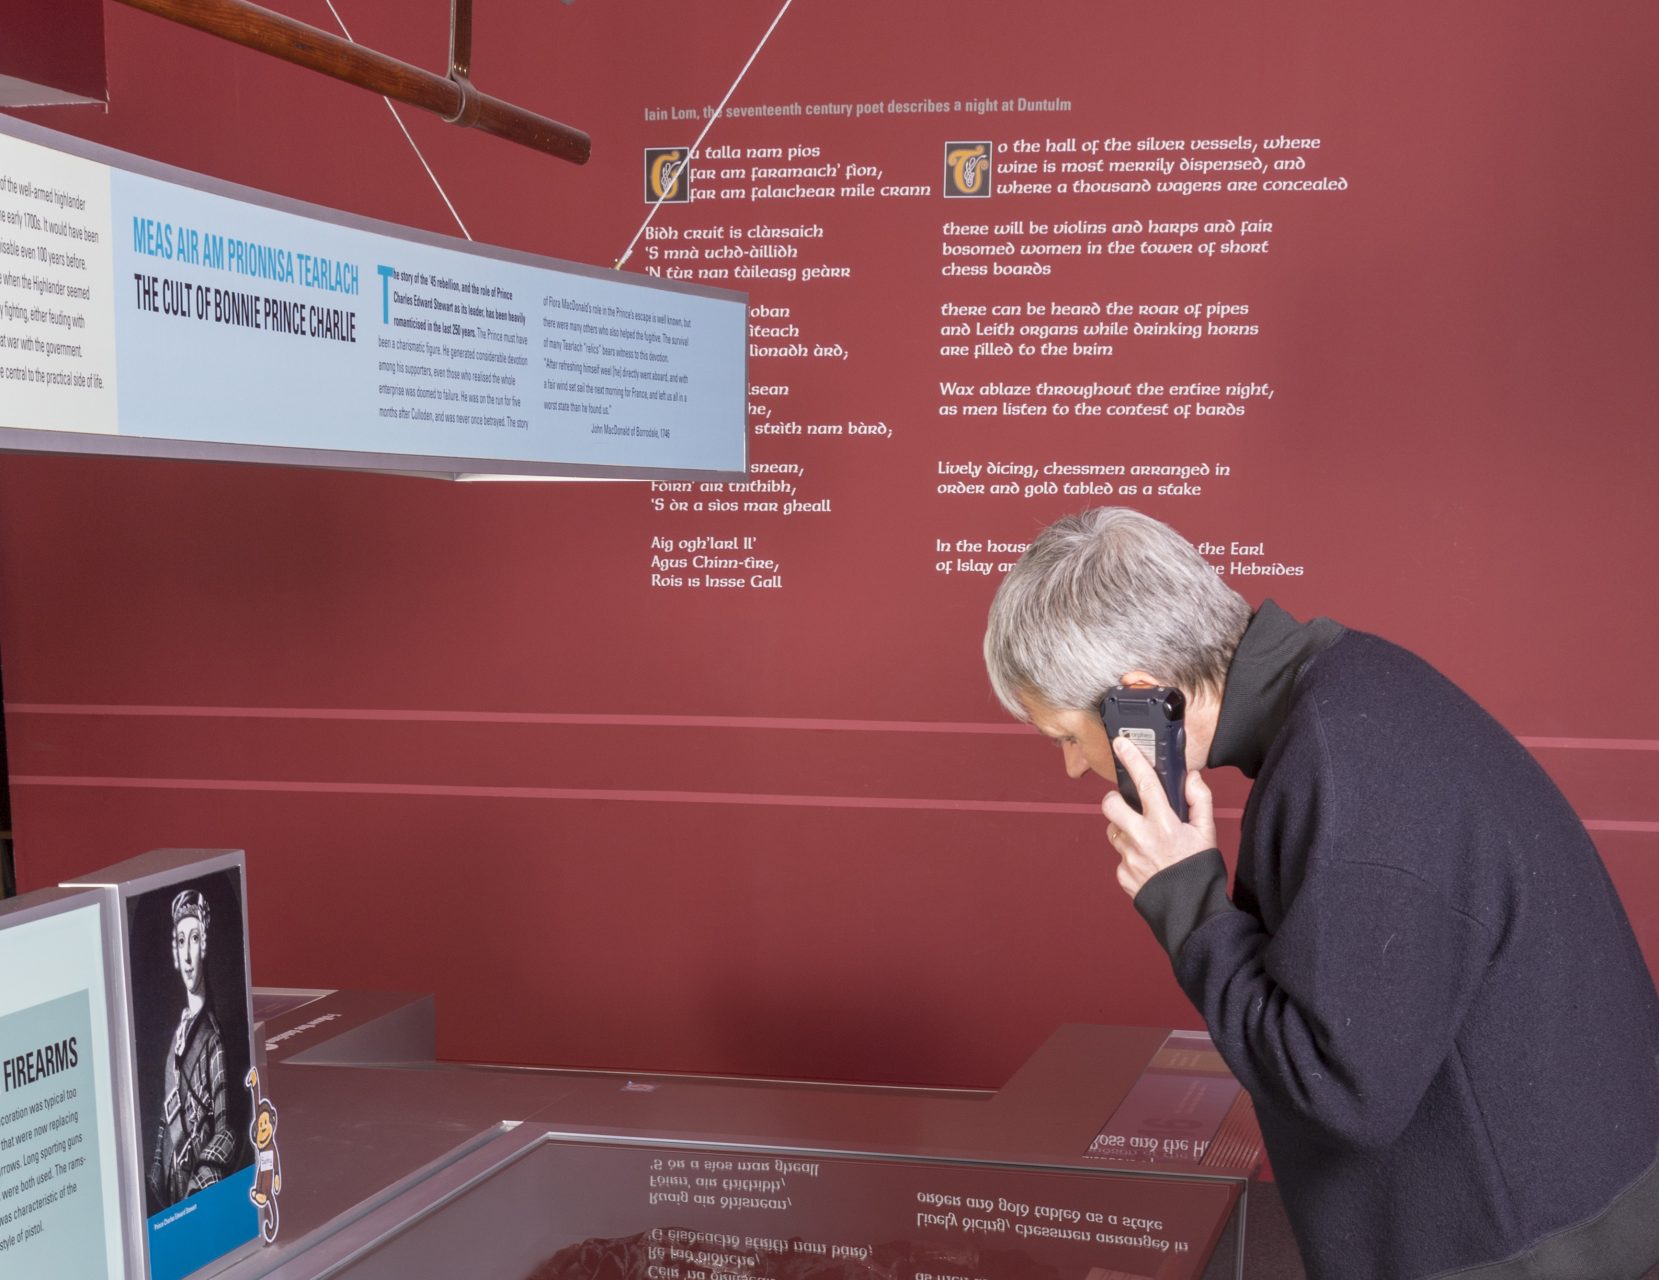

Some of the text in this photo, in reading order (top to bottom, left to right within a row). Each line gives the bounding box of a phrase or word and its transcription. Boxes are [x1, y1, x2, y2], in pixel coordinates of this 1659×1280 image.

[645, 97, 1072, 121] Iain Lom, the seventeenth century poet describes a night at Duntulm
[705, 145, 741, 159] talla
[747, 148, 782, 158] nam
[1013, 135, 1321, 155] the hall of the silver vessels, where
[997, 156, 1306, 175] wine is most merrily dispensed, and
[691, 168, 716, 182] far
[720, 169, 746, 179] am
[691, 188, 716, 202] far
[720, 189, 746, 199] am
[751, 184, 835, 201] falaichear
[880, 186, 931, 196] crann
[997, 177, 1348, 196] where a thousand wagers are concealed
[19, 181, 86, 211] well-armed highlander
[49, 219, 99, 243] would have been
[645, 224, 823, 240] Bidh cruit is clàrsaich
[943, 219, 1273, 237] there will be violins and harps and fair
[133, 216, 359, 295] MEAS AIR AM PRIONNSA TEARLACH
[943, 240, 1269, 257] bosomed women in the tower of short
[942, 262, 1051, 276] chess boards
[134, 273, 356, 343] THE CULT OF BONNIE PRINCE CHARLIE
[393, 291, 453, 313] Charles Edward Stewart
[941, 301, 1249, 318] there can be heard the roar of pipes
[940, 322, 1259, 339] and Leith organs while drinking horns
[940, 342, 1113, 359] are filled to the brim
[939, 382, 1274, 399] Wax ablaze throughout the entire night,
[939, 402, 1245, 419] as men listen to the contest of bards
[938, 461, 1230, 479] Lively dicing, chessmen arranged in
[937, 481, 1201, 498] order and gold tabled as a stake
[652, 574, 782, 588] Rois is Insse Gall
[3, 1036, 78, 1092] FIREARMS
[44, 1087, 77, 1110] typical too
[1, 1110, 79, 1151] that were now replacing
